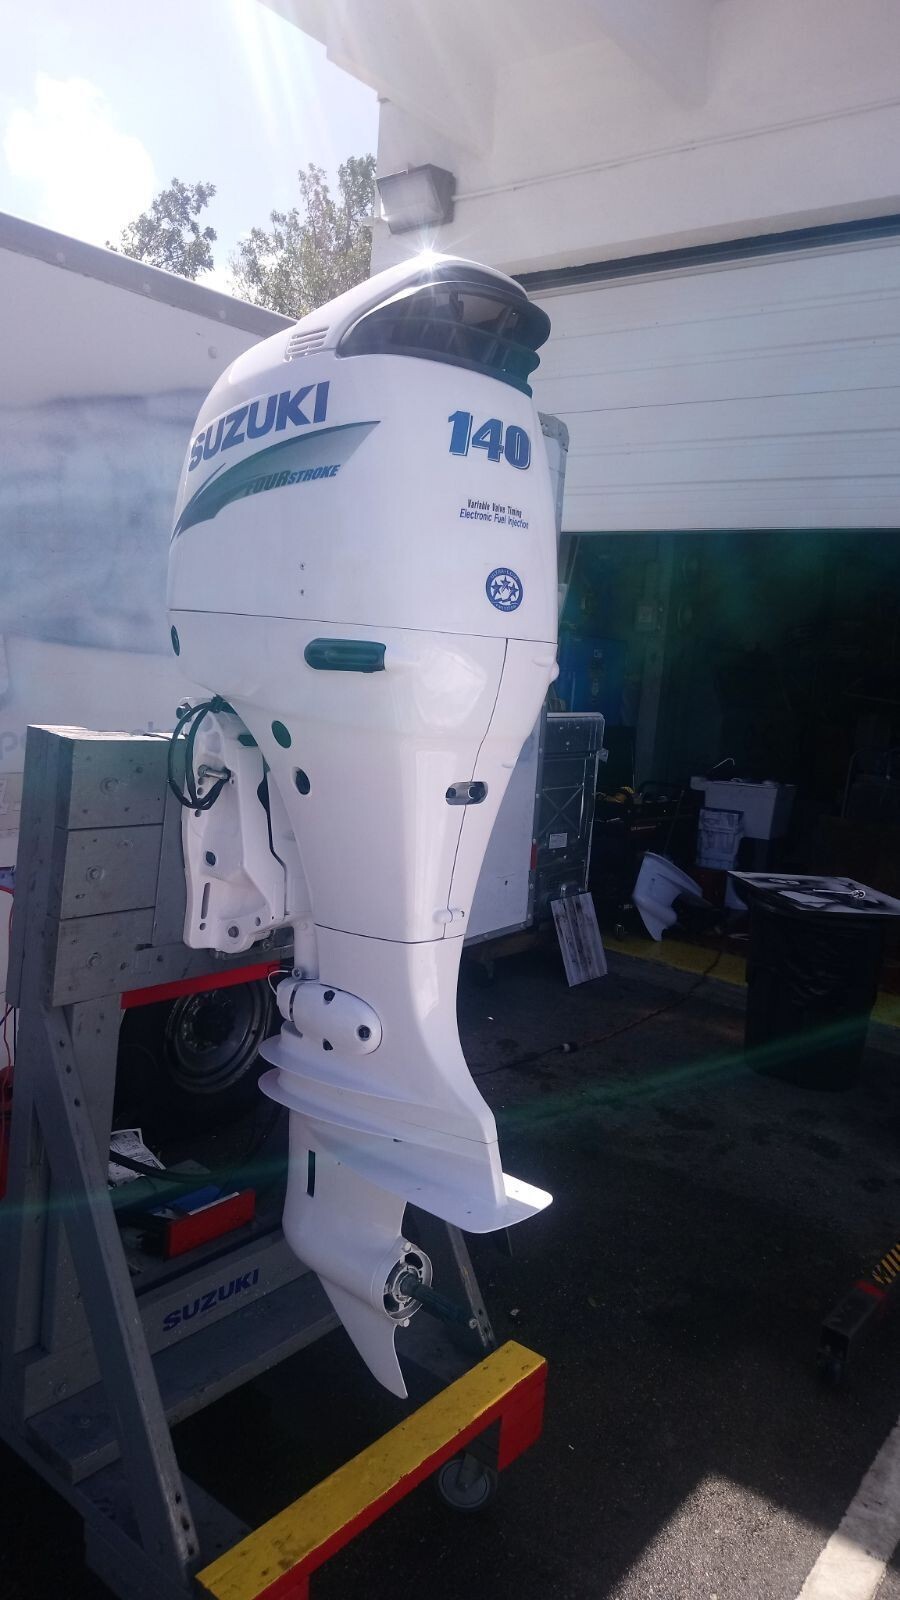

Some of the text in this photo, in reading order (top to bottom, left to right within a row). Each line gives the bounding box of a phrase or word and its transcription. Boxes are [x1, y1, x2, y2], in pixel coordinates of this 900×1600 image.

[188, 381, 330, 472] SUZUKI
[448, 410, 532, 470] 140
[459, 508, 529, 530] Electronic Fuel Injection
[467, 499, 523, 519] Variable Valve Timing
[162, 1268, 259, 1332] SUZUKI
